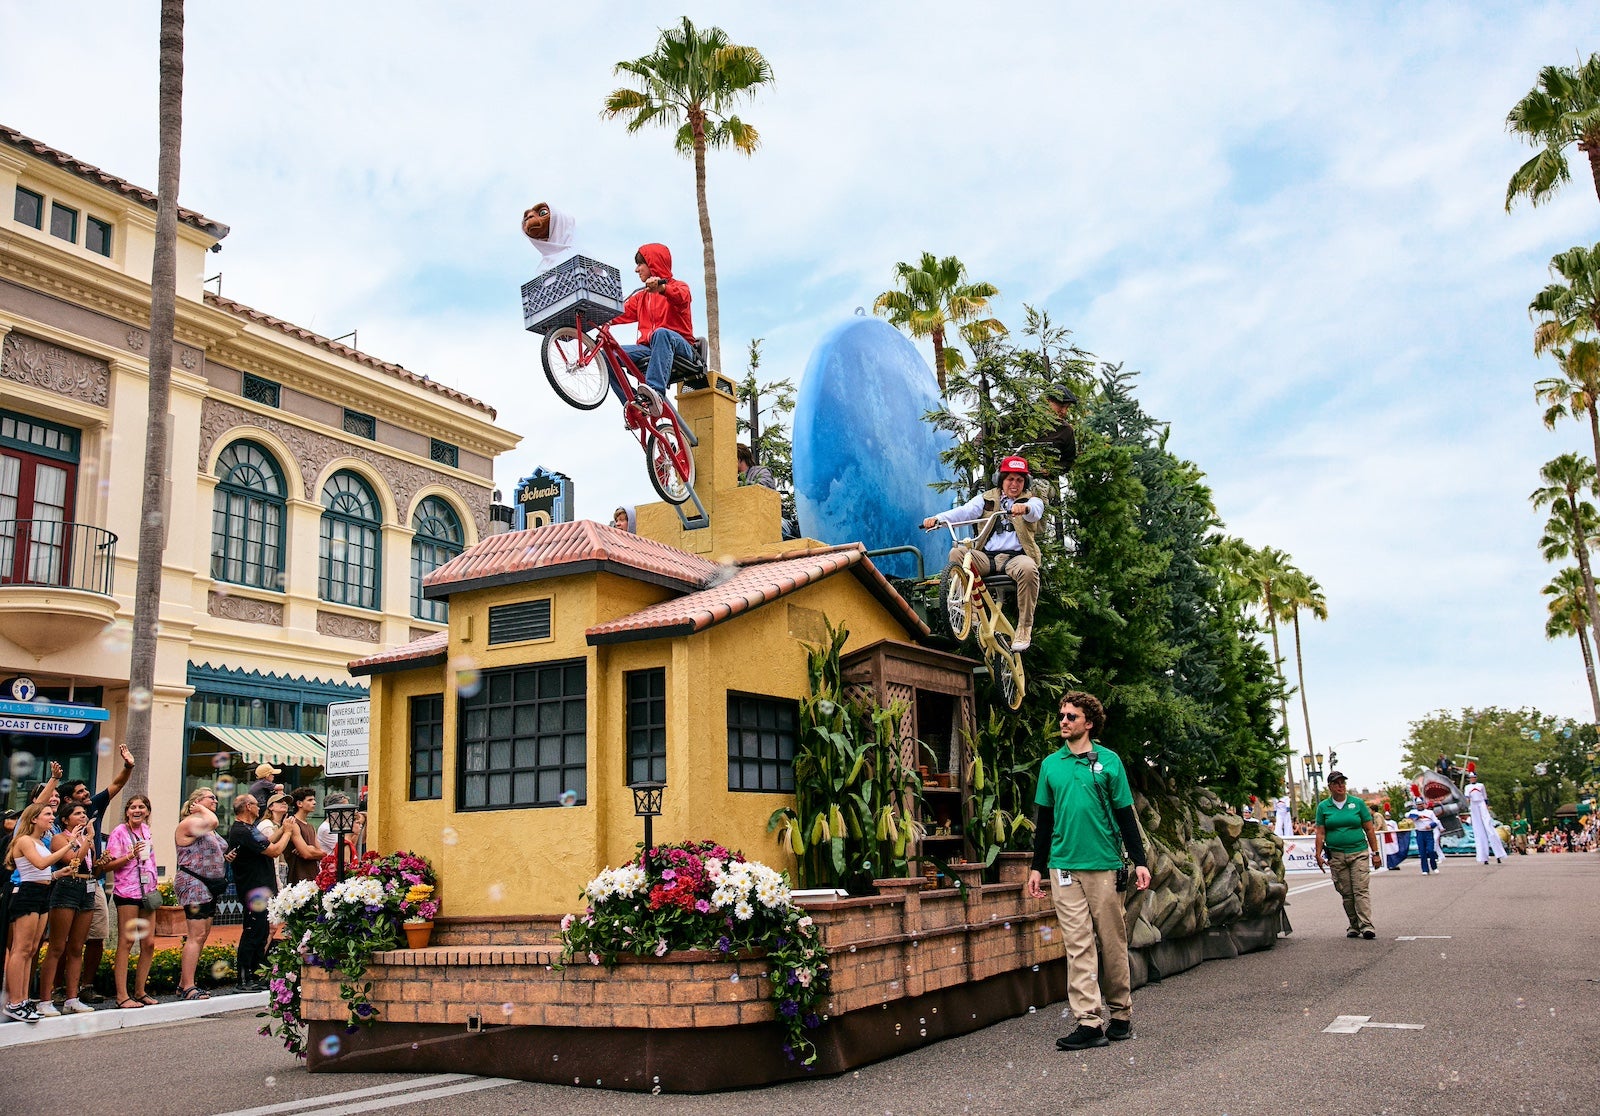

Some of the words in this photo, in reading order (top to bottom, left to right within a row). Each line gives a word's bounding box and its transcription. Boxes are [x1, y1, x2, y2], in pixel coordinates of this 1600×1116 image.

[332, 707, 356, 716] UNIVERSAL
[357, 706, 366, 714] CITY
[34, 722, 69, 732] CENTER
[332, 718, 346, 727] NORTH
[331, 729, 340, 737] SAN
[341, 727, 364, 736] FERNANDO
[331, 739, 348, 747] SAUGUS
[330, 749, 360, 759] BAKERSFIELD
[330, 760, 350, 769] OAKLAND
